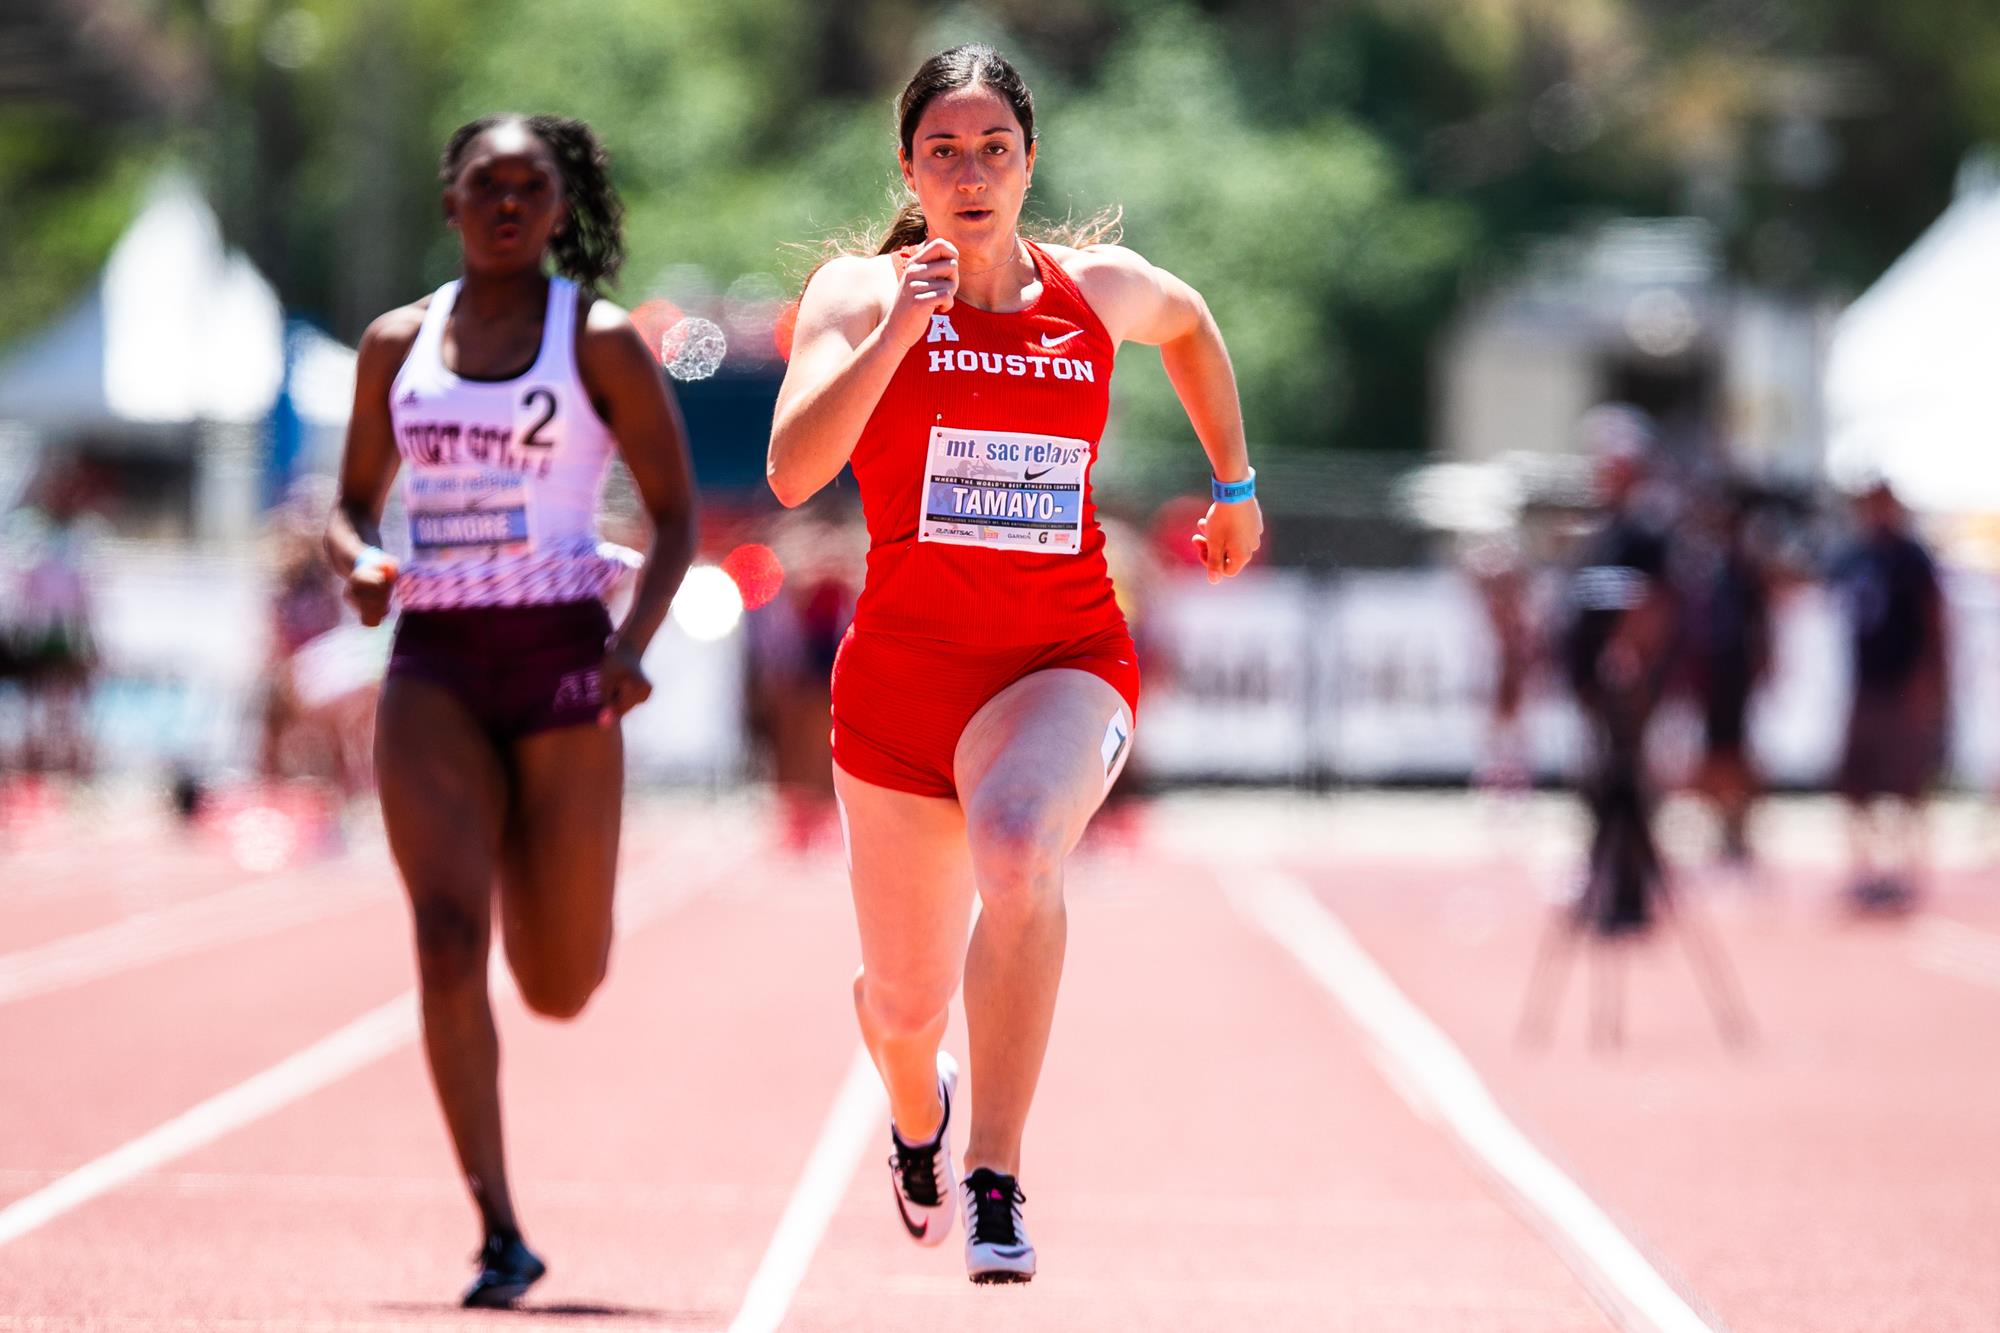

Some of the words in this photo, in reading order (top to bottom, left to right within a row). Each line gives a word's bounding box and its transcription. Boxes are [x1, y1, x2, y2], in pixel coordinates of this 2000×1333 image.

[928, 349, 1095, 383] HOUSTON
[520, 387, 558, 448] 2
[946, 439, 980, 459] mt.
[986, 442, 1019, 462] sac
[1024, 442, 1081, 466] relays
[976, 480, 1006, 488] WORLD'S
[952, 486, 1063, 521] TAMAYO-
